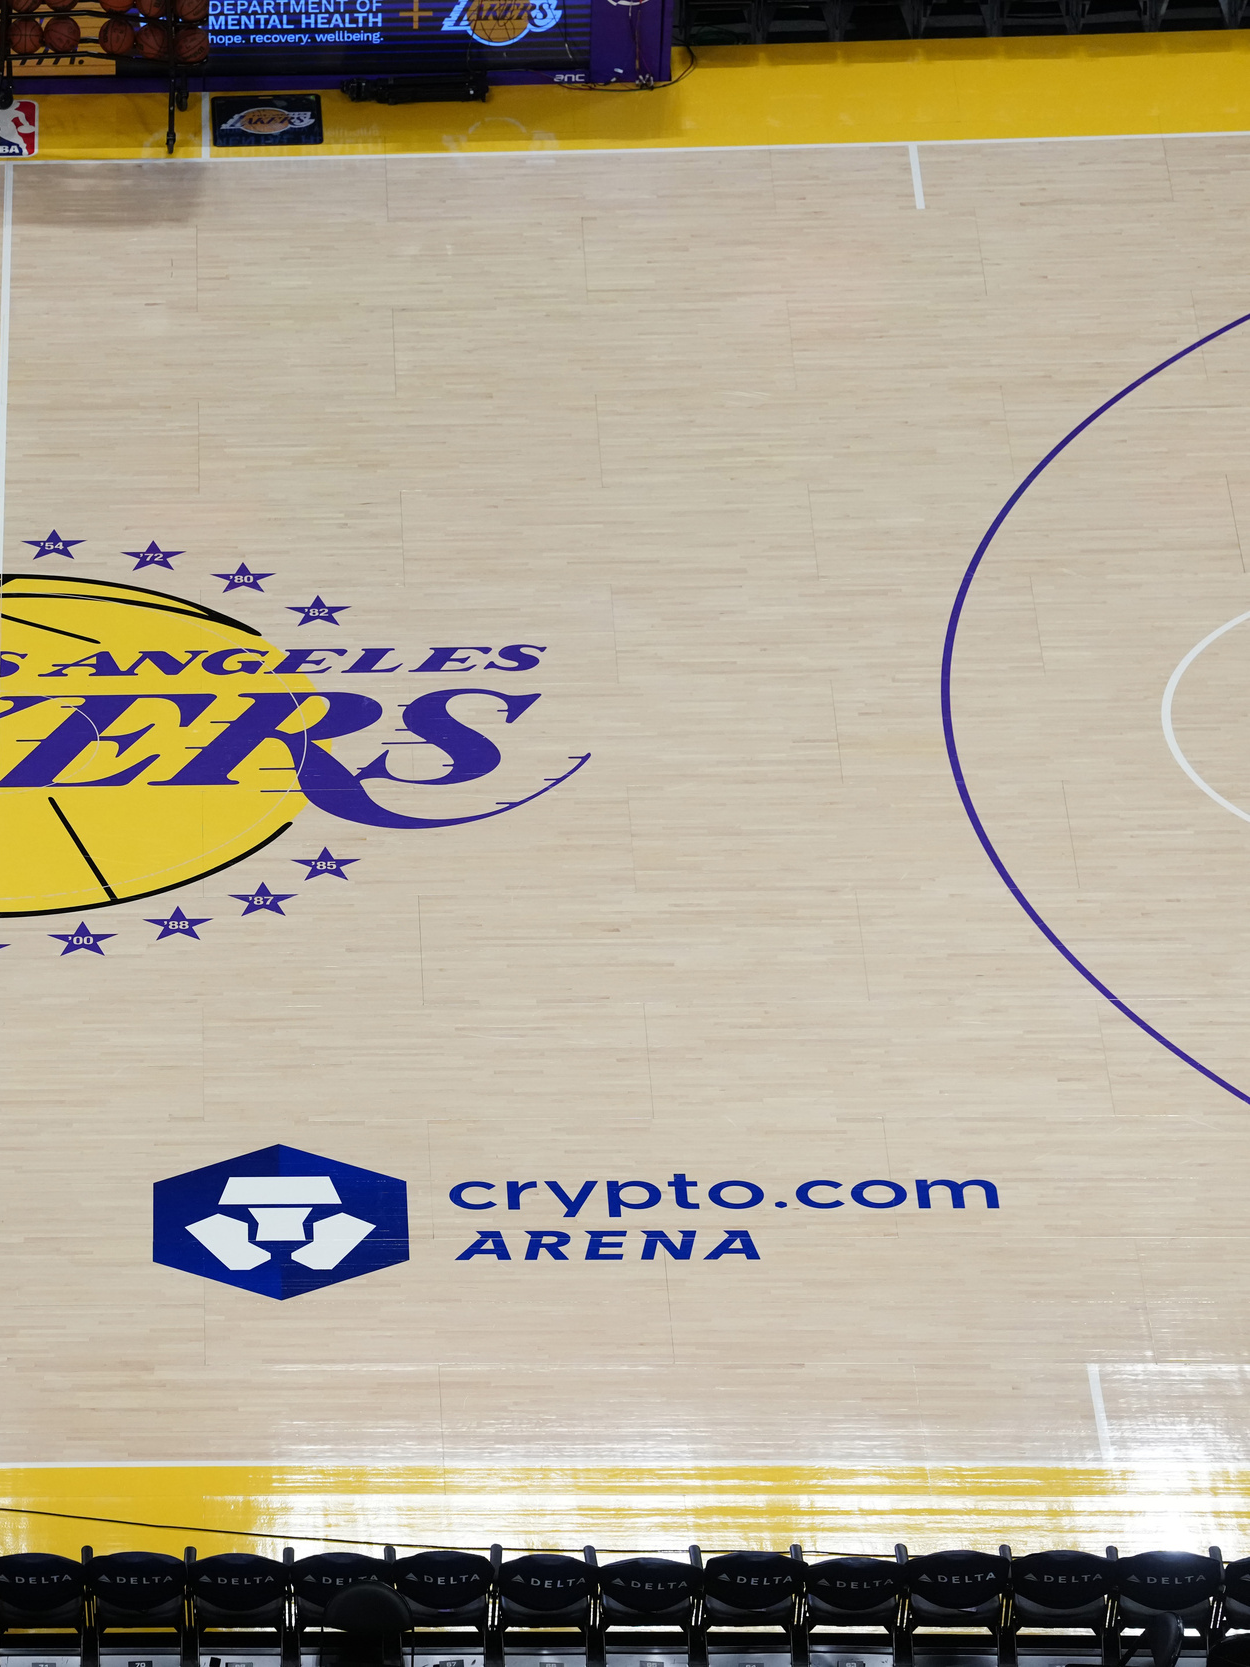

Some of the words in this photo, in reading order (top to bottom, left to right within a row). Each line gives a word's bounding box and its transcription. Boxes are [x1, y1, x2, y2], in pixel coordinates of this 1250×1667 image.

[208, 0, 346, 14] DEPARTMENT
[356, 0, 382, 12] OF
[208, 14, 294, 30] MENTAL
[301, 13, 382, 28] HEALTH
[208, 33, 246, 46] hope.
[250, 33, 311, 45] recovery.
[315, 30, 384, 43] wellbeing.
[39, 540, 65, 551] '54
[138, 552, 164, 563] '72
[228, 574, 254, 585] '80
[303, 608, 329, 618] '82
[37, 644, 548, 677] ANGELES
[309, 860, 337, 871] '85
[247, 896, 275, 906] '87
[162, 920, 190, 931] '88
[67, 934, 95, 946] '00
[449, 1173, 1000, 1218] crypto.com
[455, 1229, 761, 1261] ARENA
[15, 1574, 72, 1585] DELTA
[116, 1575, 173, 1585] DELTA
[217, 1575, 275, 1586] DELTA
[423, 1573, 480, 1585] DELTA
[530, 1577, 586, 1589] DELTA
[736, 1575, 793, 1586] DELTA
[937, 1571, 996, 1584] DELTA
[1043, 1573, 1103, 1584] DELTA
[1146, 1574, 1206, 1585] DELTA
[630, 1580, 688, 1591] DELTA
[836, 1578, 894, 1590] DELTA
